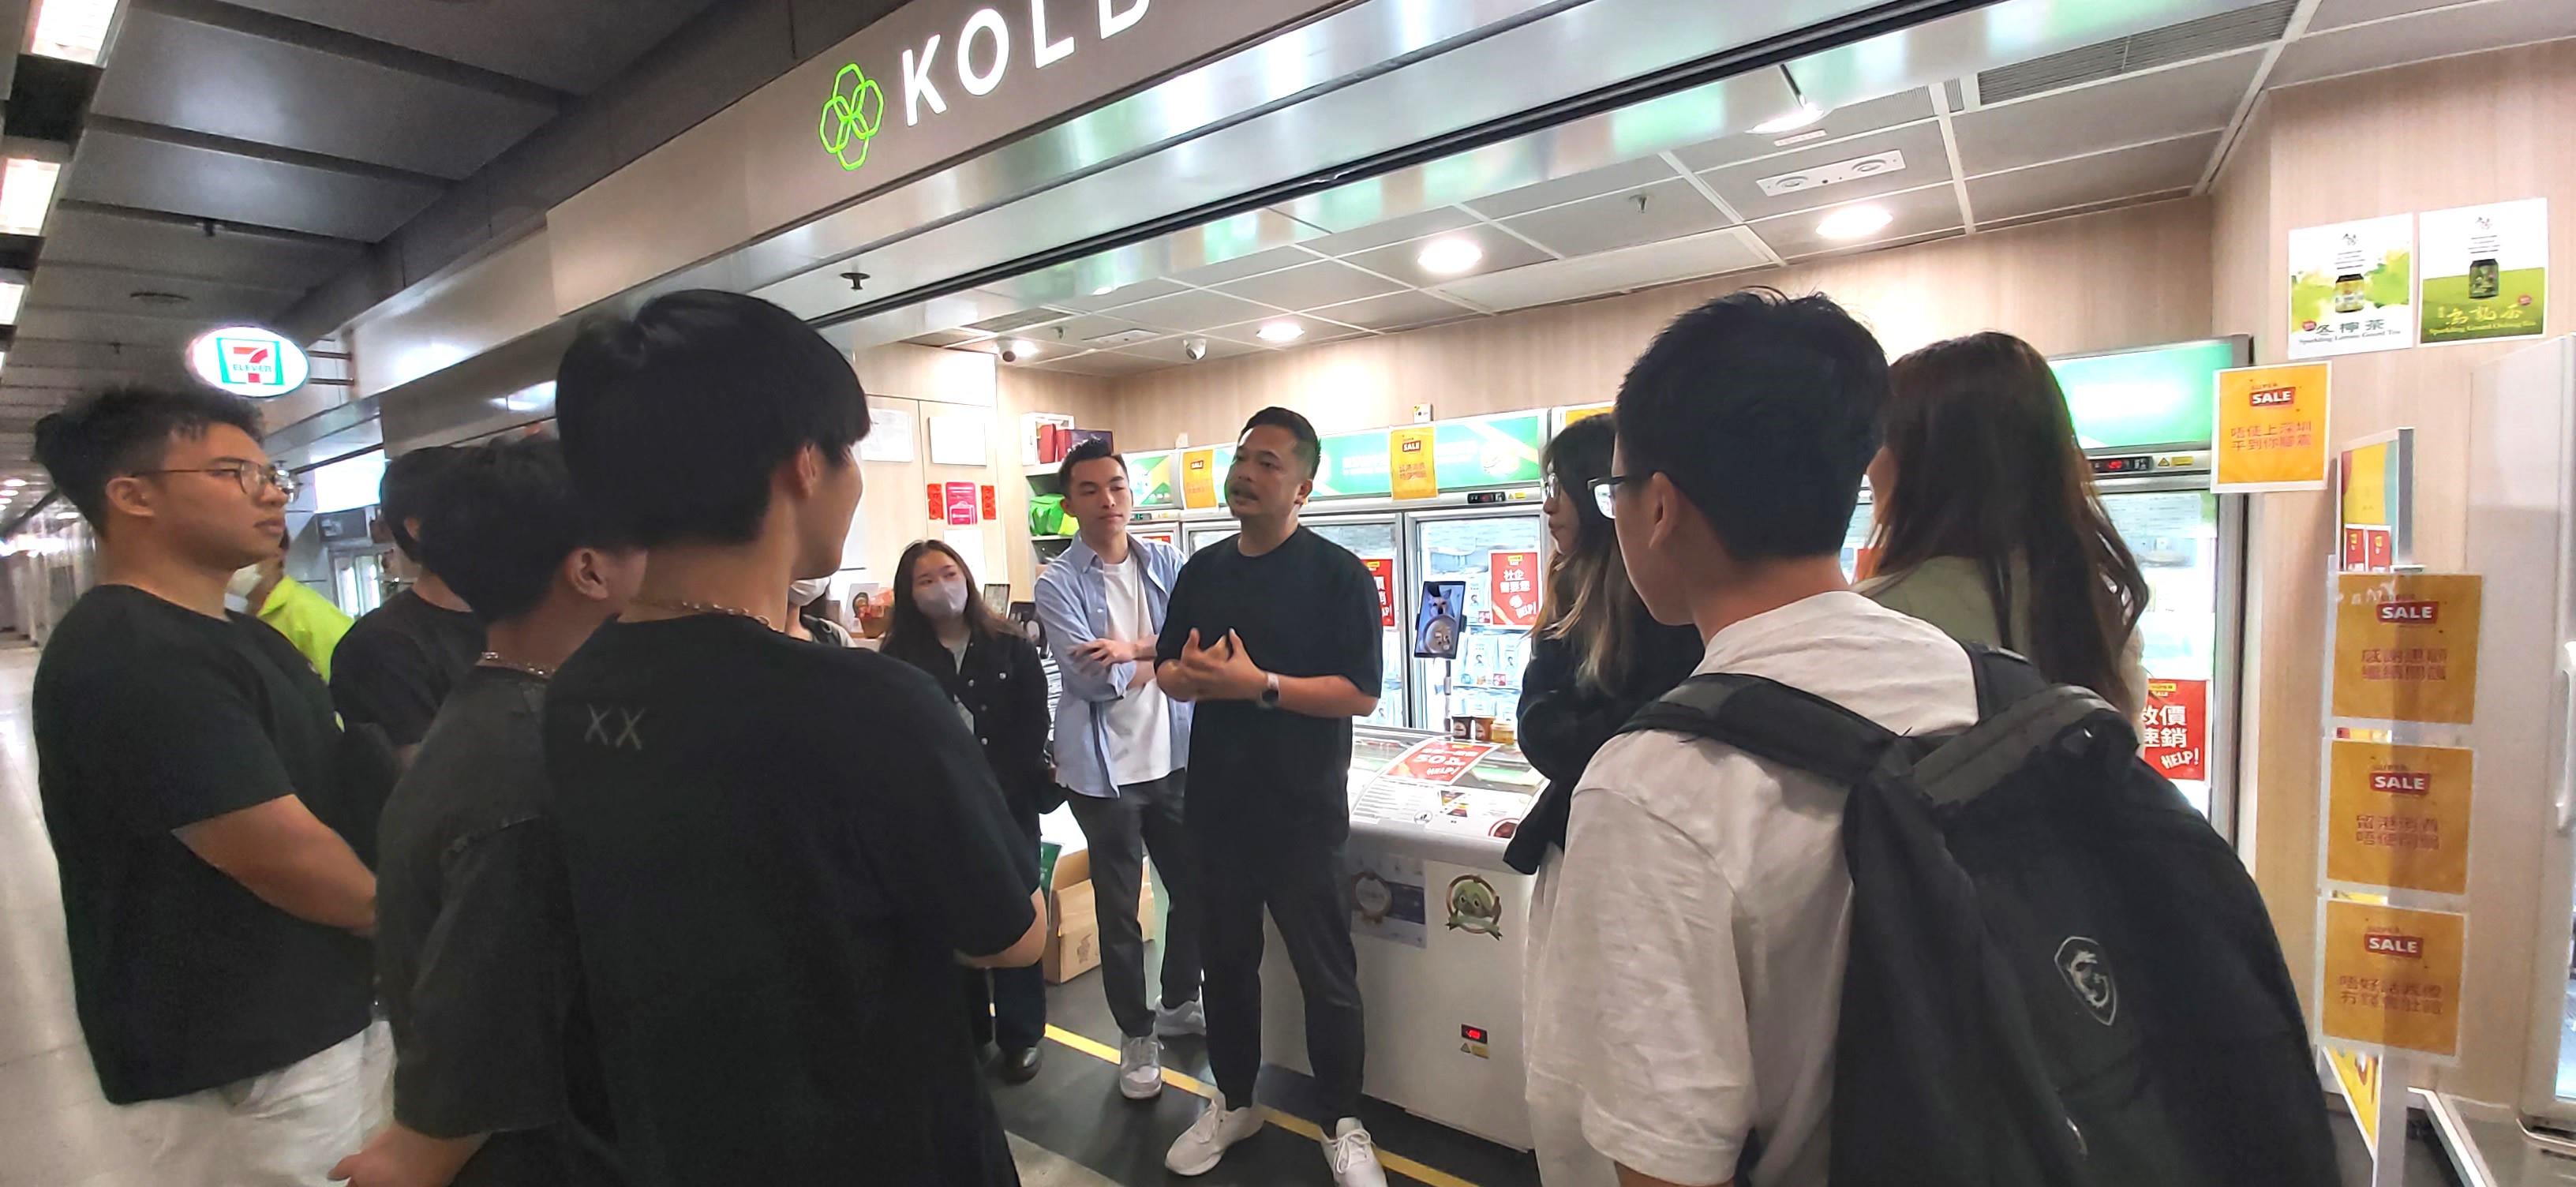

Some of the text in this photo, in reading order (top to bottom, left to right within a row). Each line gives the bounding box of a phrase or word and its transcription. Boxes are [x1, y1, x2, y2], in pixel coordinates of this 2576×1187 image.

[233, 347, 268, 383] 7
[2252, 390, 2292, 404] SALE
[1403, 442, 1420, 451] SALE
[2381, 606, 2432, 620] SALE
[2160, 747, 2200, 769] HELP!
[1426, 766, 1461, 775] HELP!
[2375, 776, 2424, 790] SALE
[2369, 938, 2417, 953] SALE
